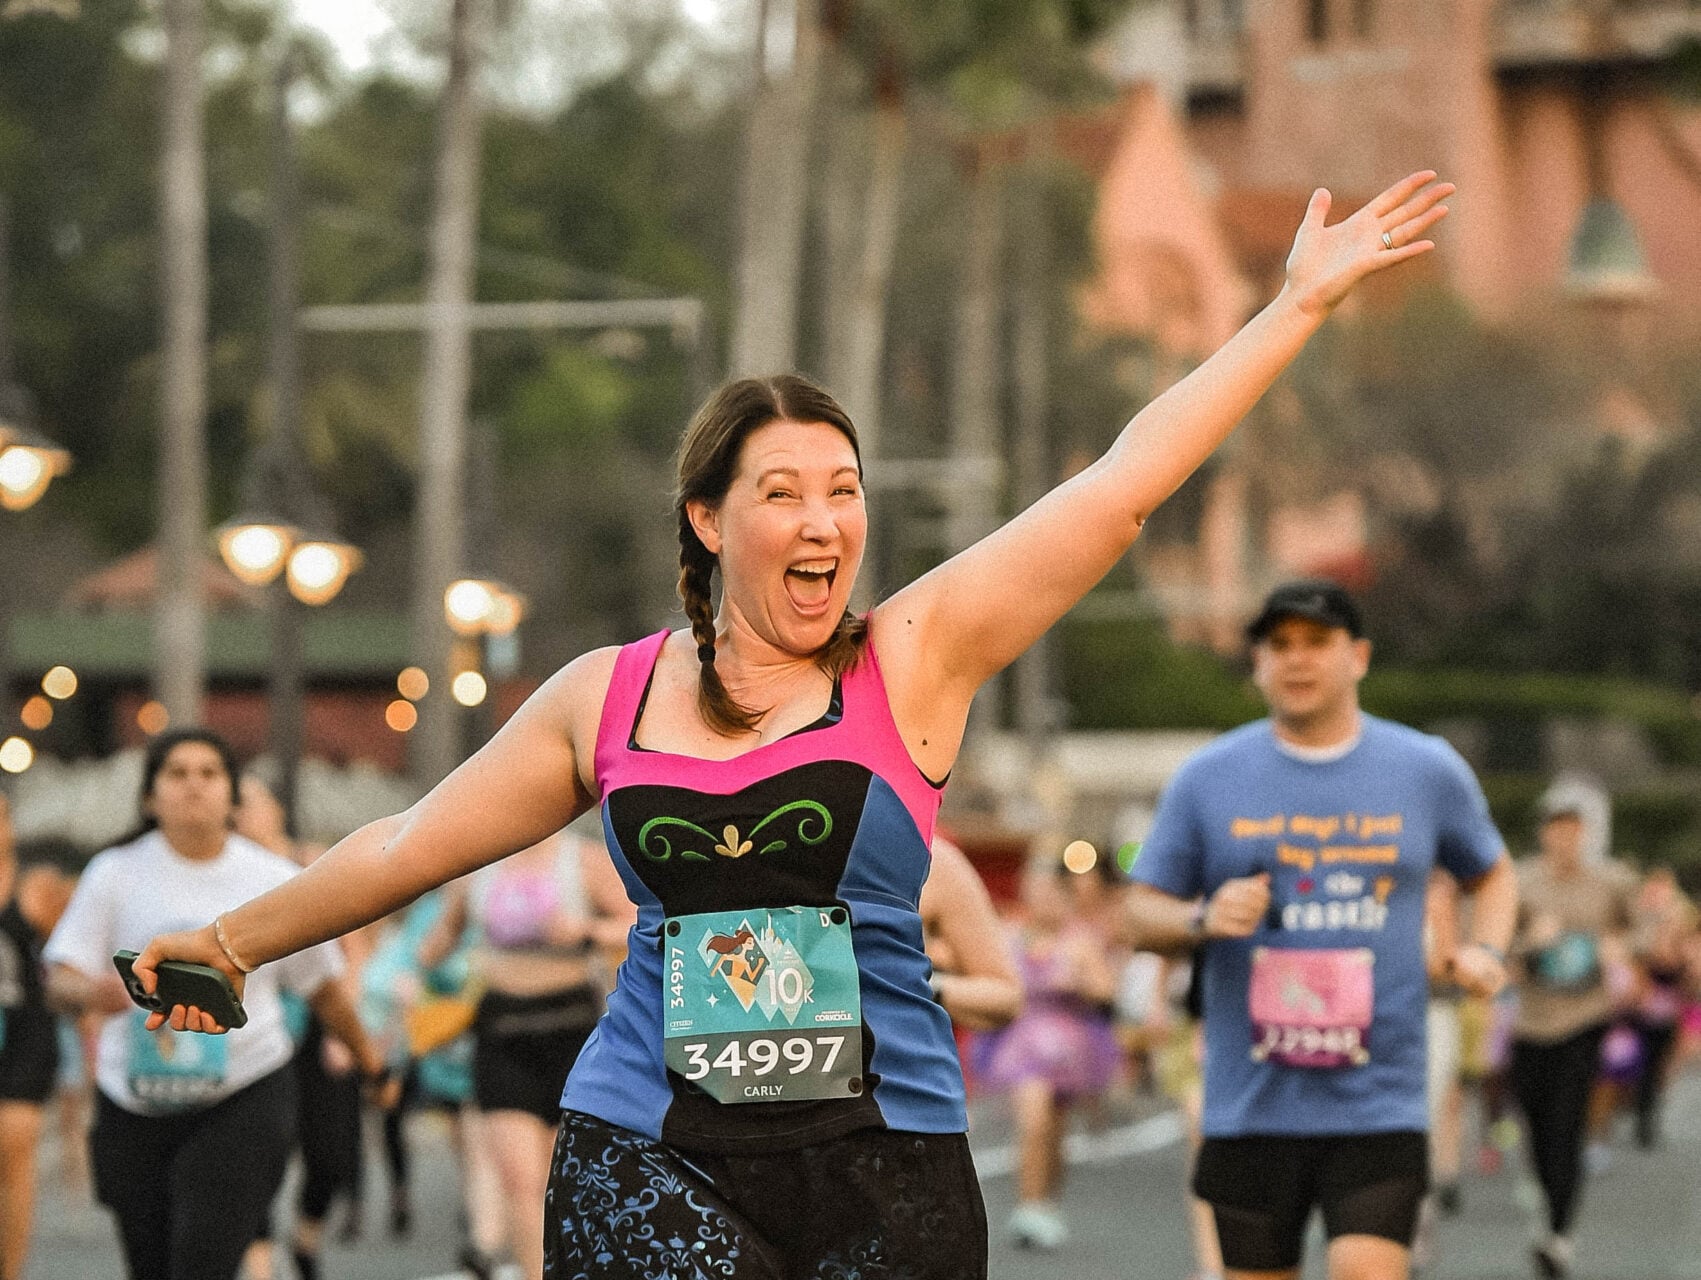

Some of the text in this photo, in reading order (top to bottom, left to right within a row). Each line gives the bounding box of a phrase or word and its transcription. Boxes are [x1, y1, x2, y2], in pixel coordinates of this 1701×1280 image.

[671, 947, 685, 1009] 34997
[683, 1036, 845, 1080] 34997
[744, 1085, 783, 1097] CARLY
